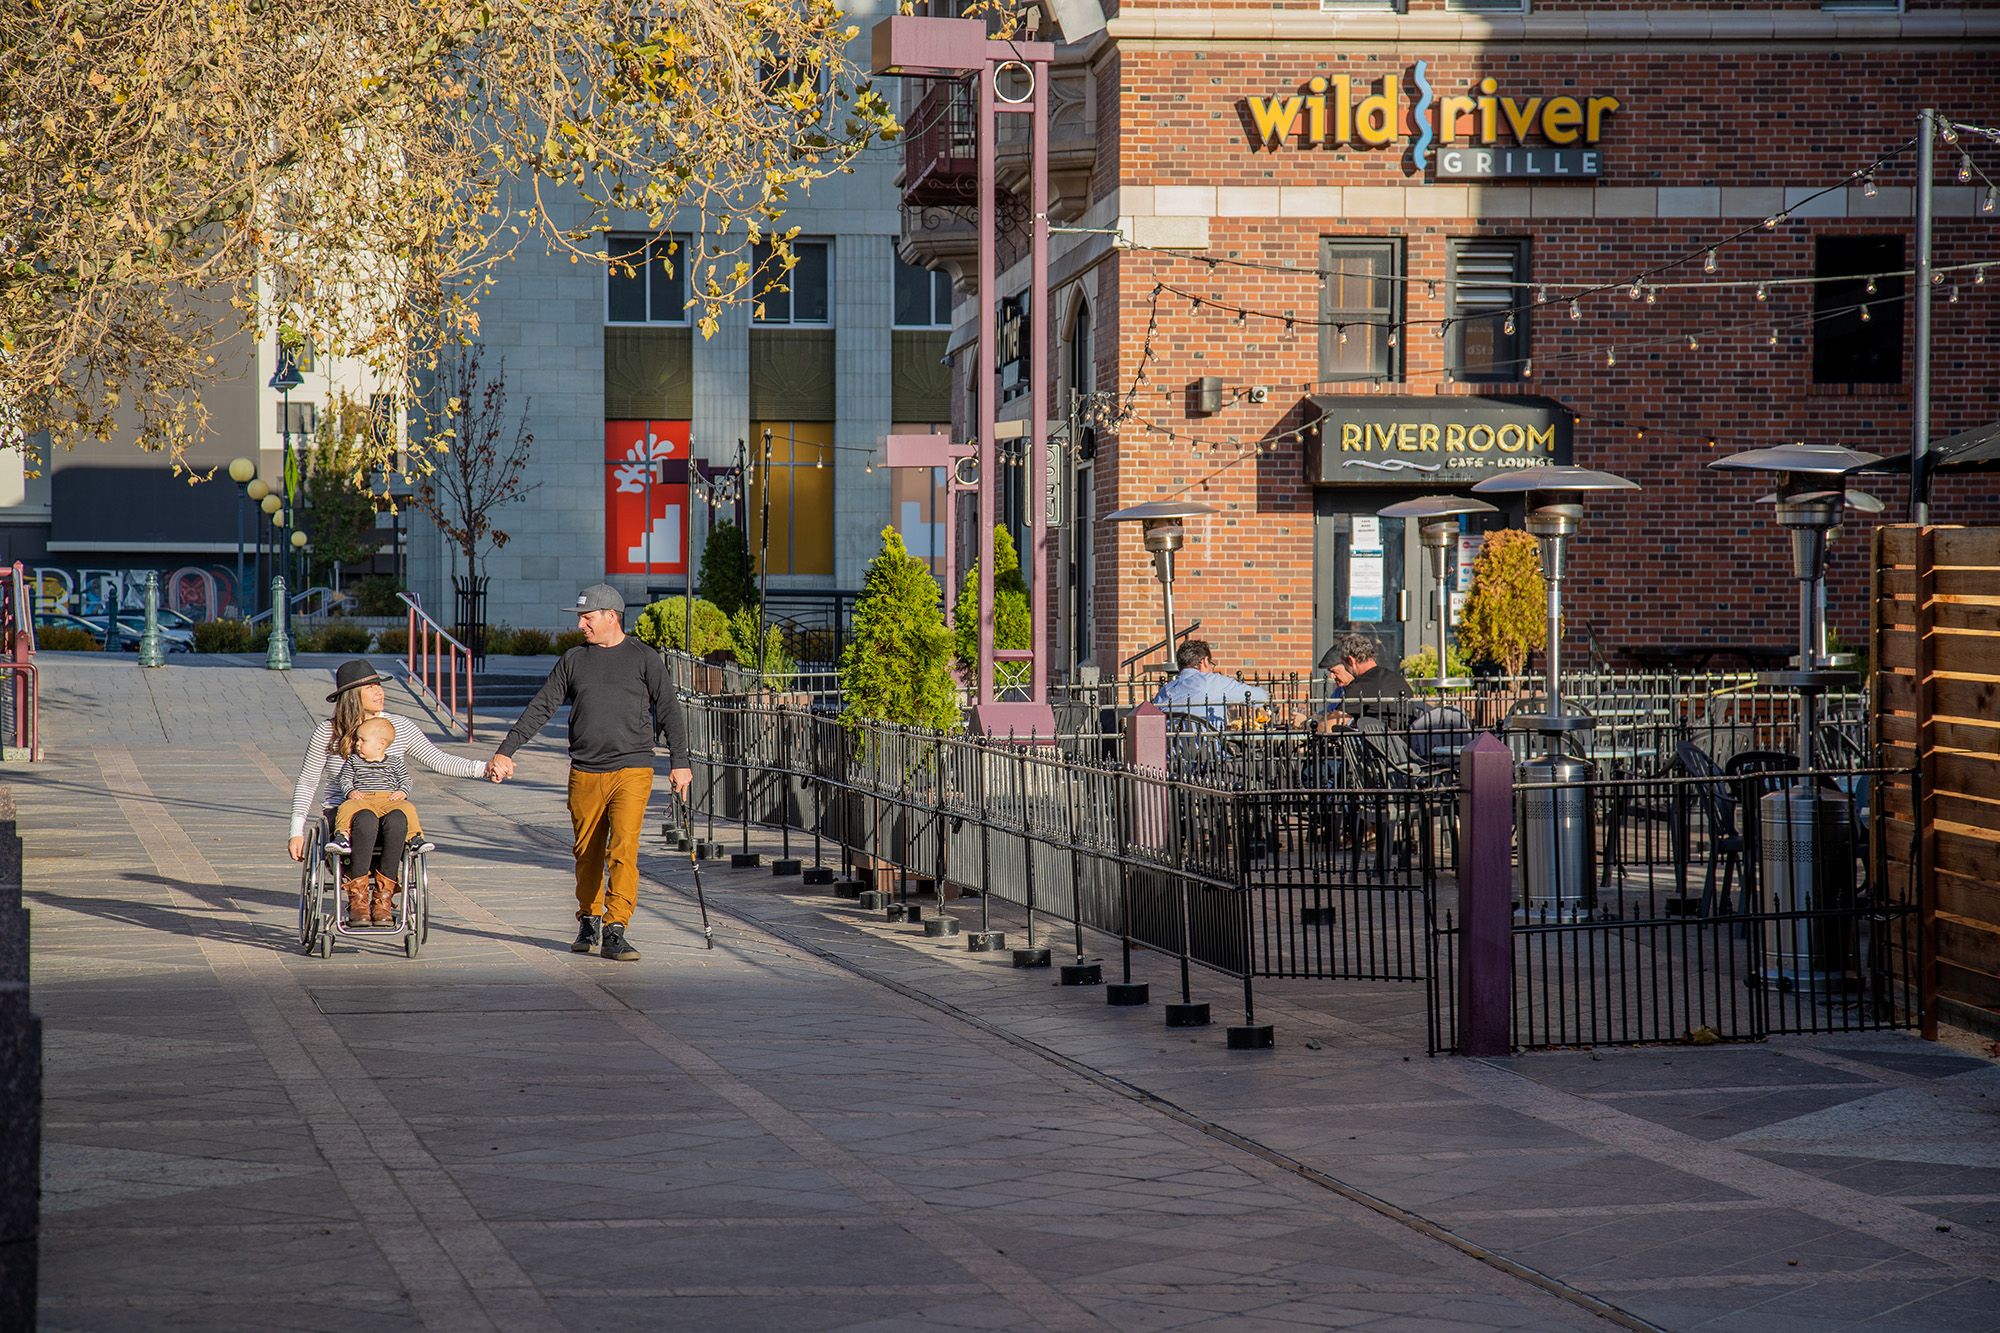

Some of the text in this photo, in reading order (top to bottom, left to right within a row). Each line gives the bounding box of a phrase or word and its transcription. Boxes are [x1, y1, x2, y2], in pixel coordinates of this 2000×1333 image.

[1246, 73, 1620, 147] wild river
[1443, 151, 1598, 173] GRILLE
[1340, 422, 1556, 452] RIVER ROOM
[1448, 456, 1484, 468] CAFE
